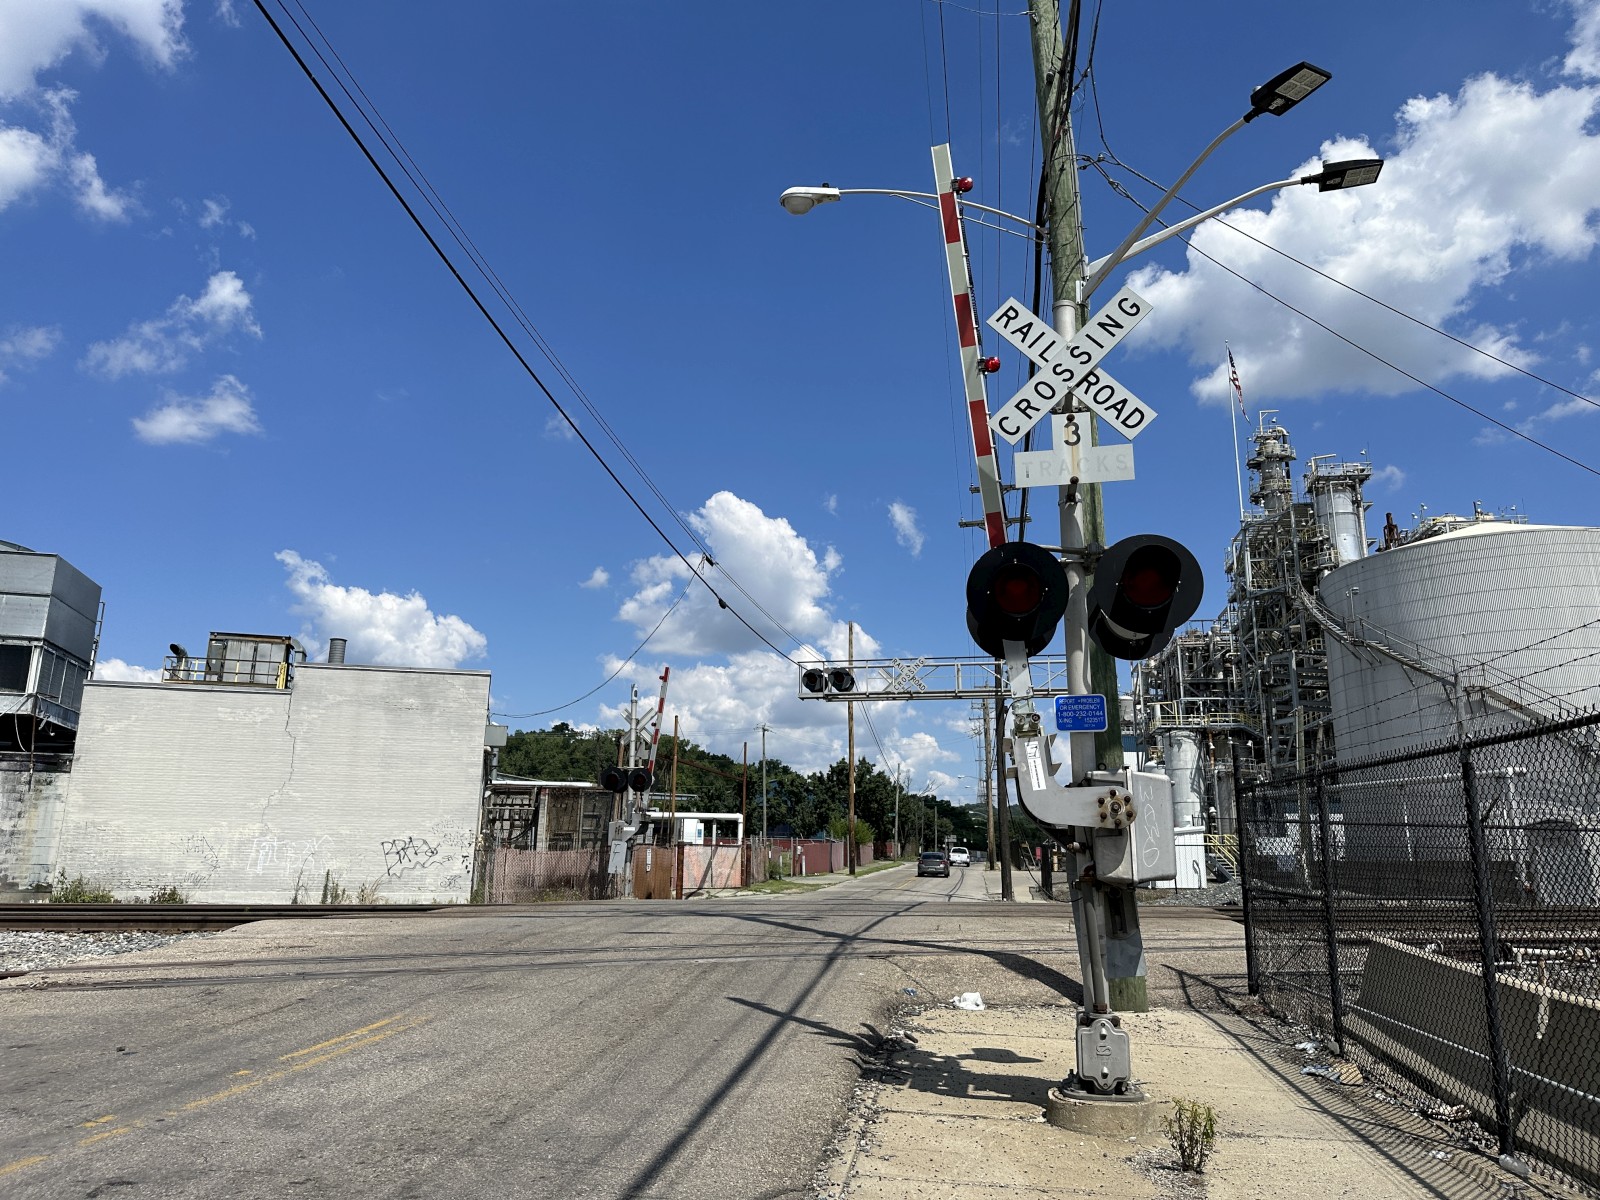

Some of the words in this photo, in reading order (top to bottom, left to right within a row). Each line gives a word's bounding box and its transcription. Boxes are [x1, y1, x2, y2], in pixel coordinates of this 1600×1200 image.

[995, 305, 1056, 363] RAIL
[1082, 370, 1145, 429] ROAD
[998, 297, 1141, 436] CROSSING
[1063, 421, 1081, 446] 3
[1022, 454, 1128, 478] TRACKS
[891, 658, 906, 673] RAIL
[911, 676, 926, 691] ROAD
[894, 658, 924, 691] CROSSING
